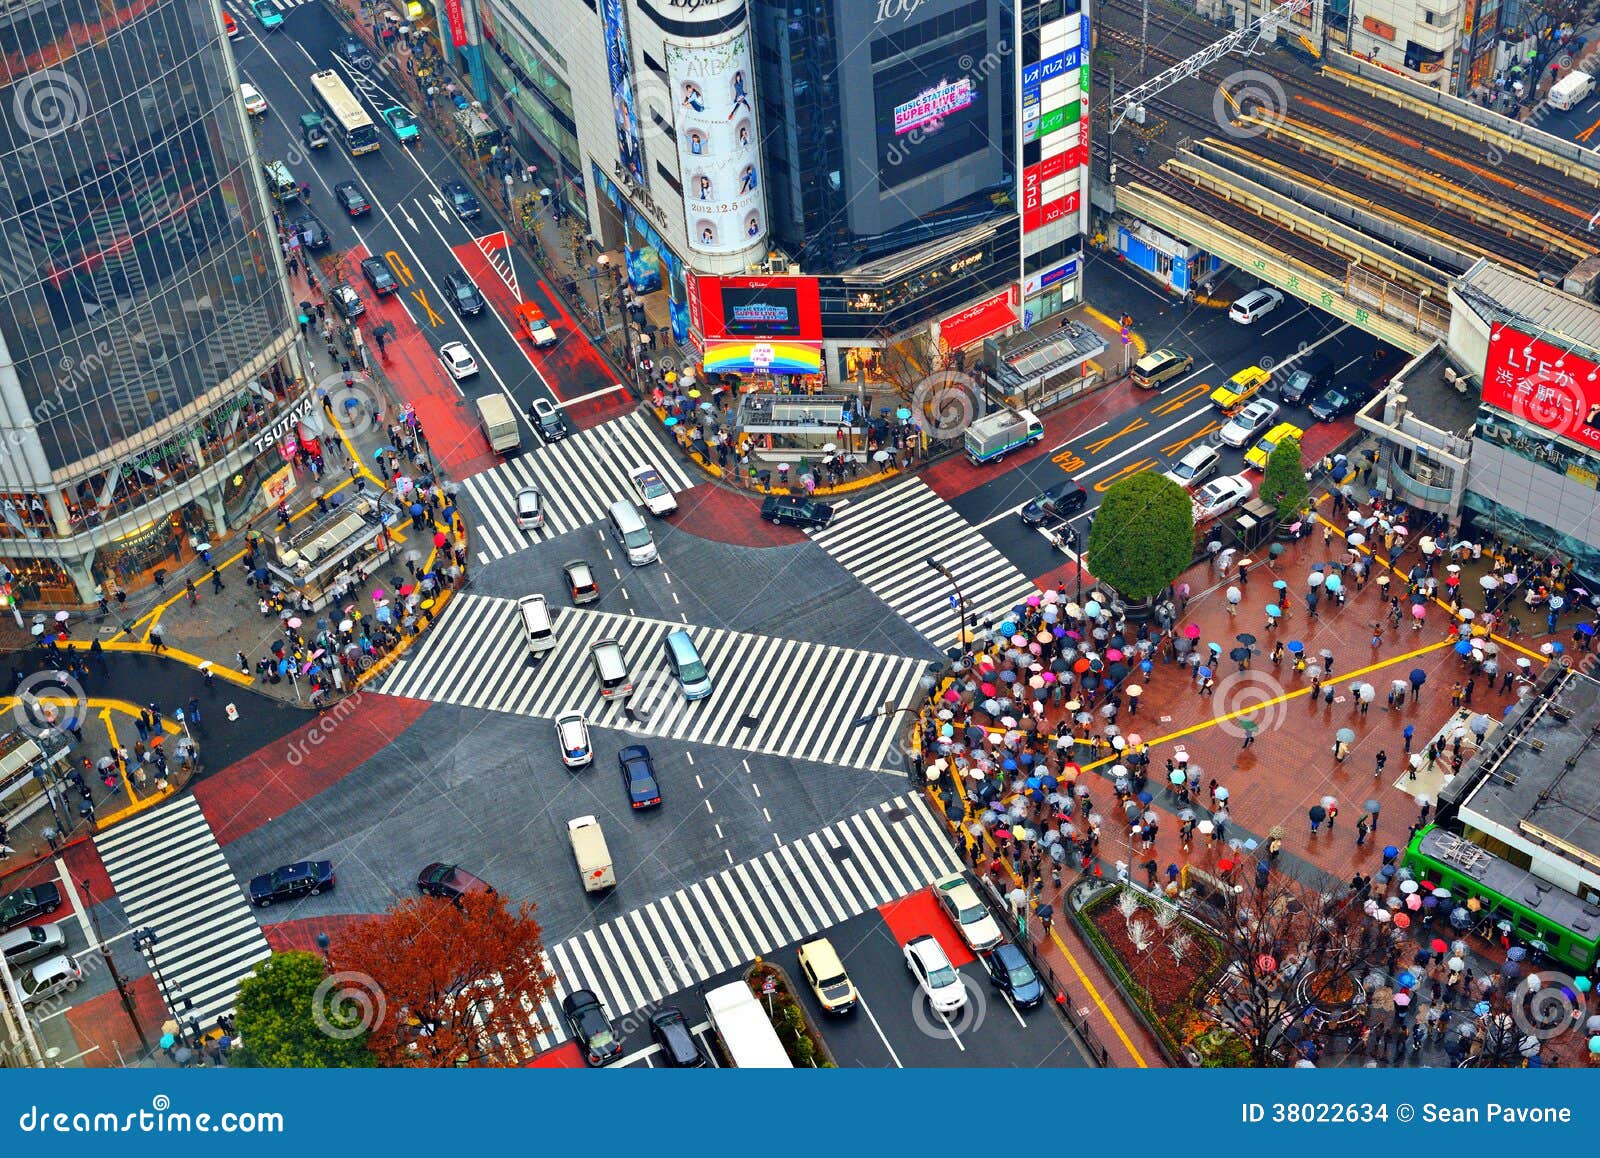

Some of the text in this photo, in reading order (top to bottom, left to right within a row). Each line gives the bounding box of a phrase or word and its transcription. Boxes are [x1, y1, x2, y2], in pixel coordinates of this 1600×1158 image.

[896, 92, 956, 125] SUPER LIVE
[1026, 174, 1037, 209] アコム
[1508, 347, 1575, 387] LTEが
[254, 398, 312, 454] TSUTAYA
[1051, 450, 1086, 473] 8-20
